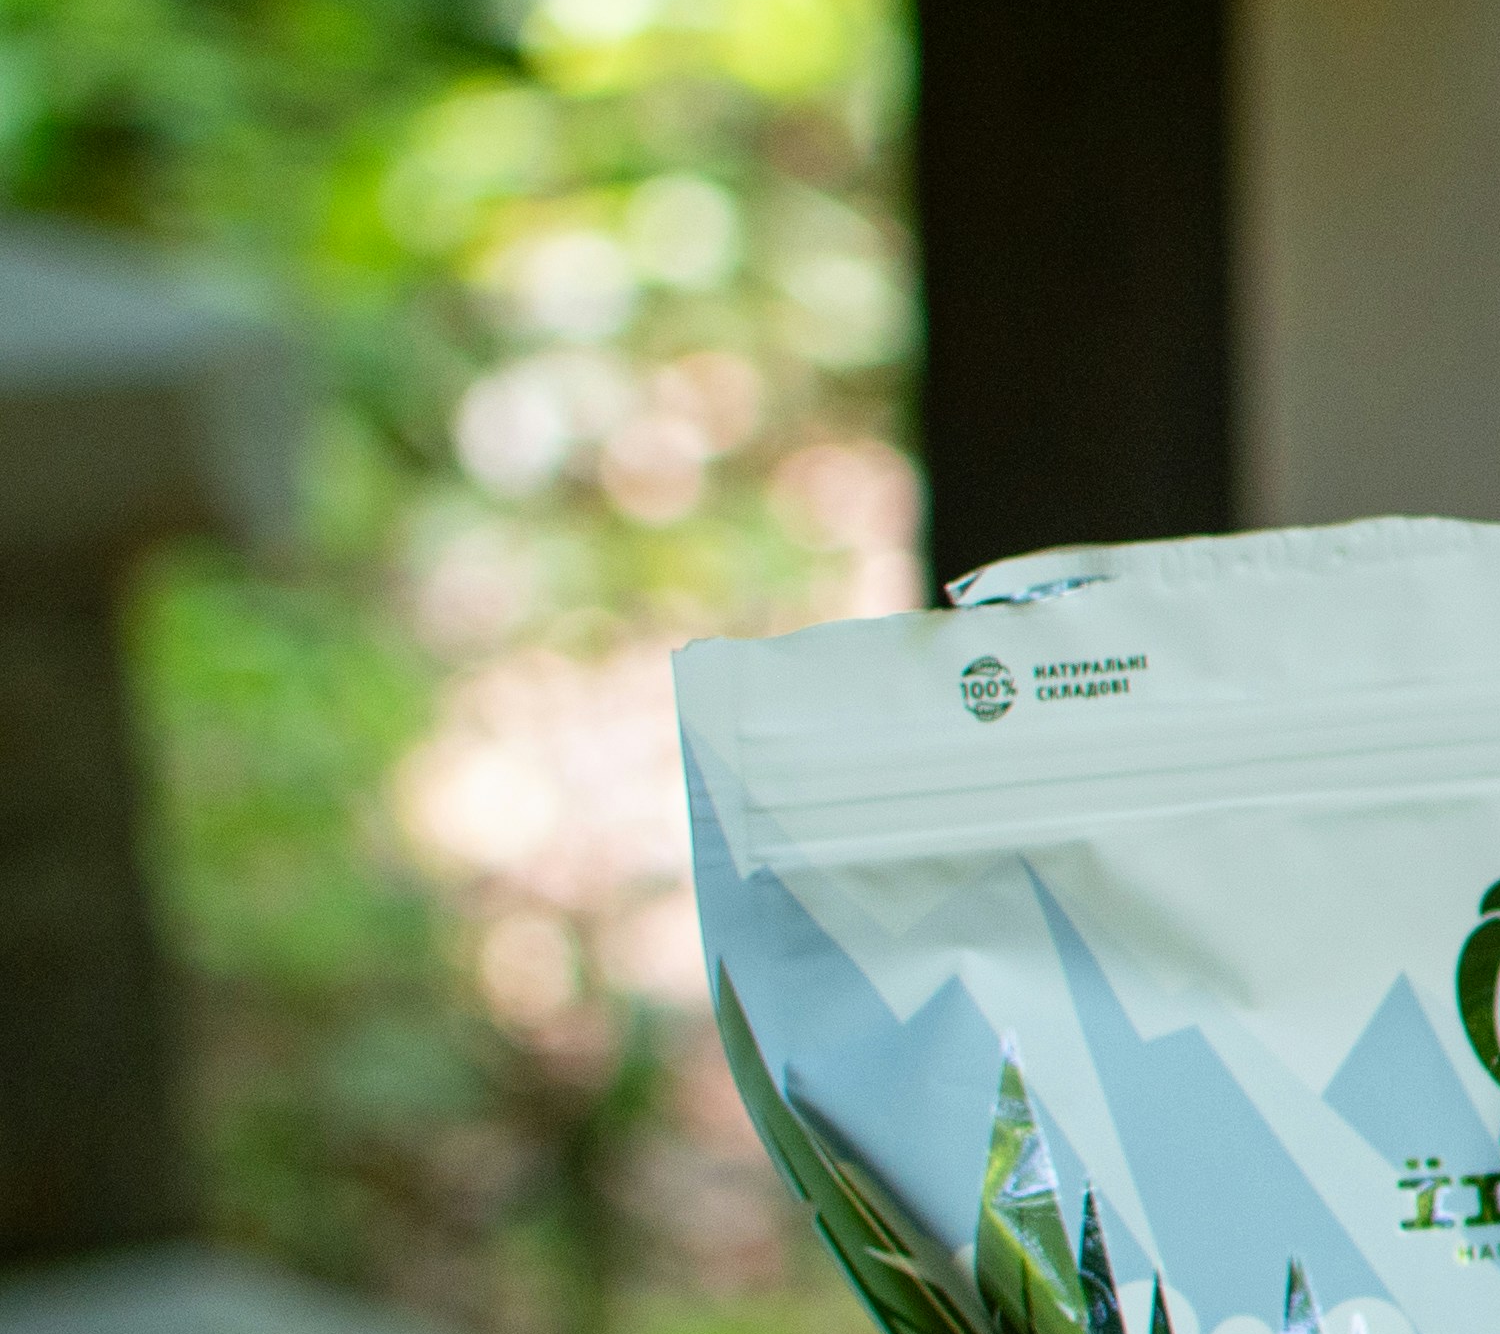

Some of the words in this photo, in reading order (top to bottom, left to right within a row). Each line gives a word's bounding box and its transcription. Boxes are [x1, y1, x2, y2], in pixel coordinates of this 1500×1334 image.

[1033, 654, 1148, 679] НАТУРАЛЬНІ
[959, 677, 1018, 701] 100%
[1035, 677, 1131, 701] СКЛАДОВІ
